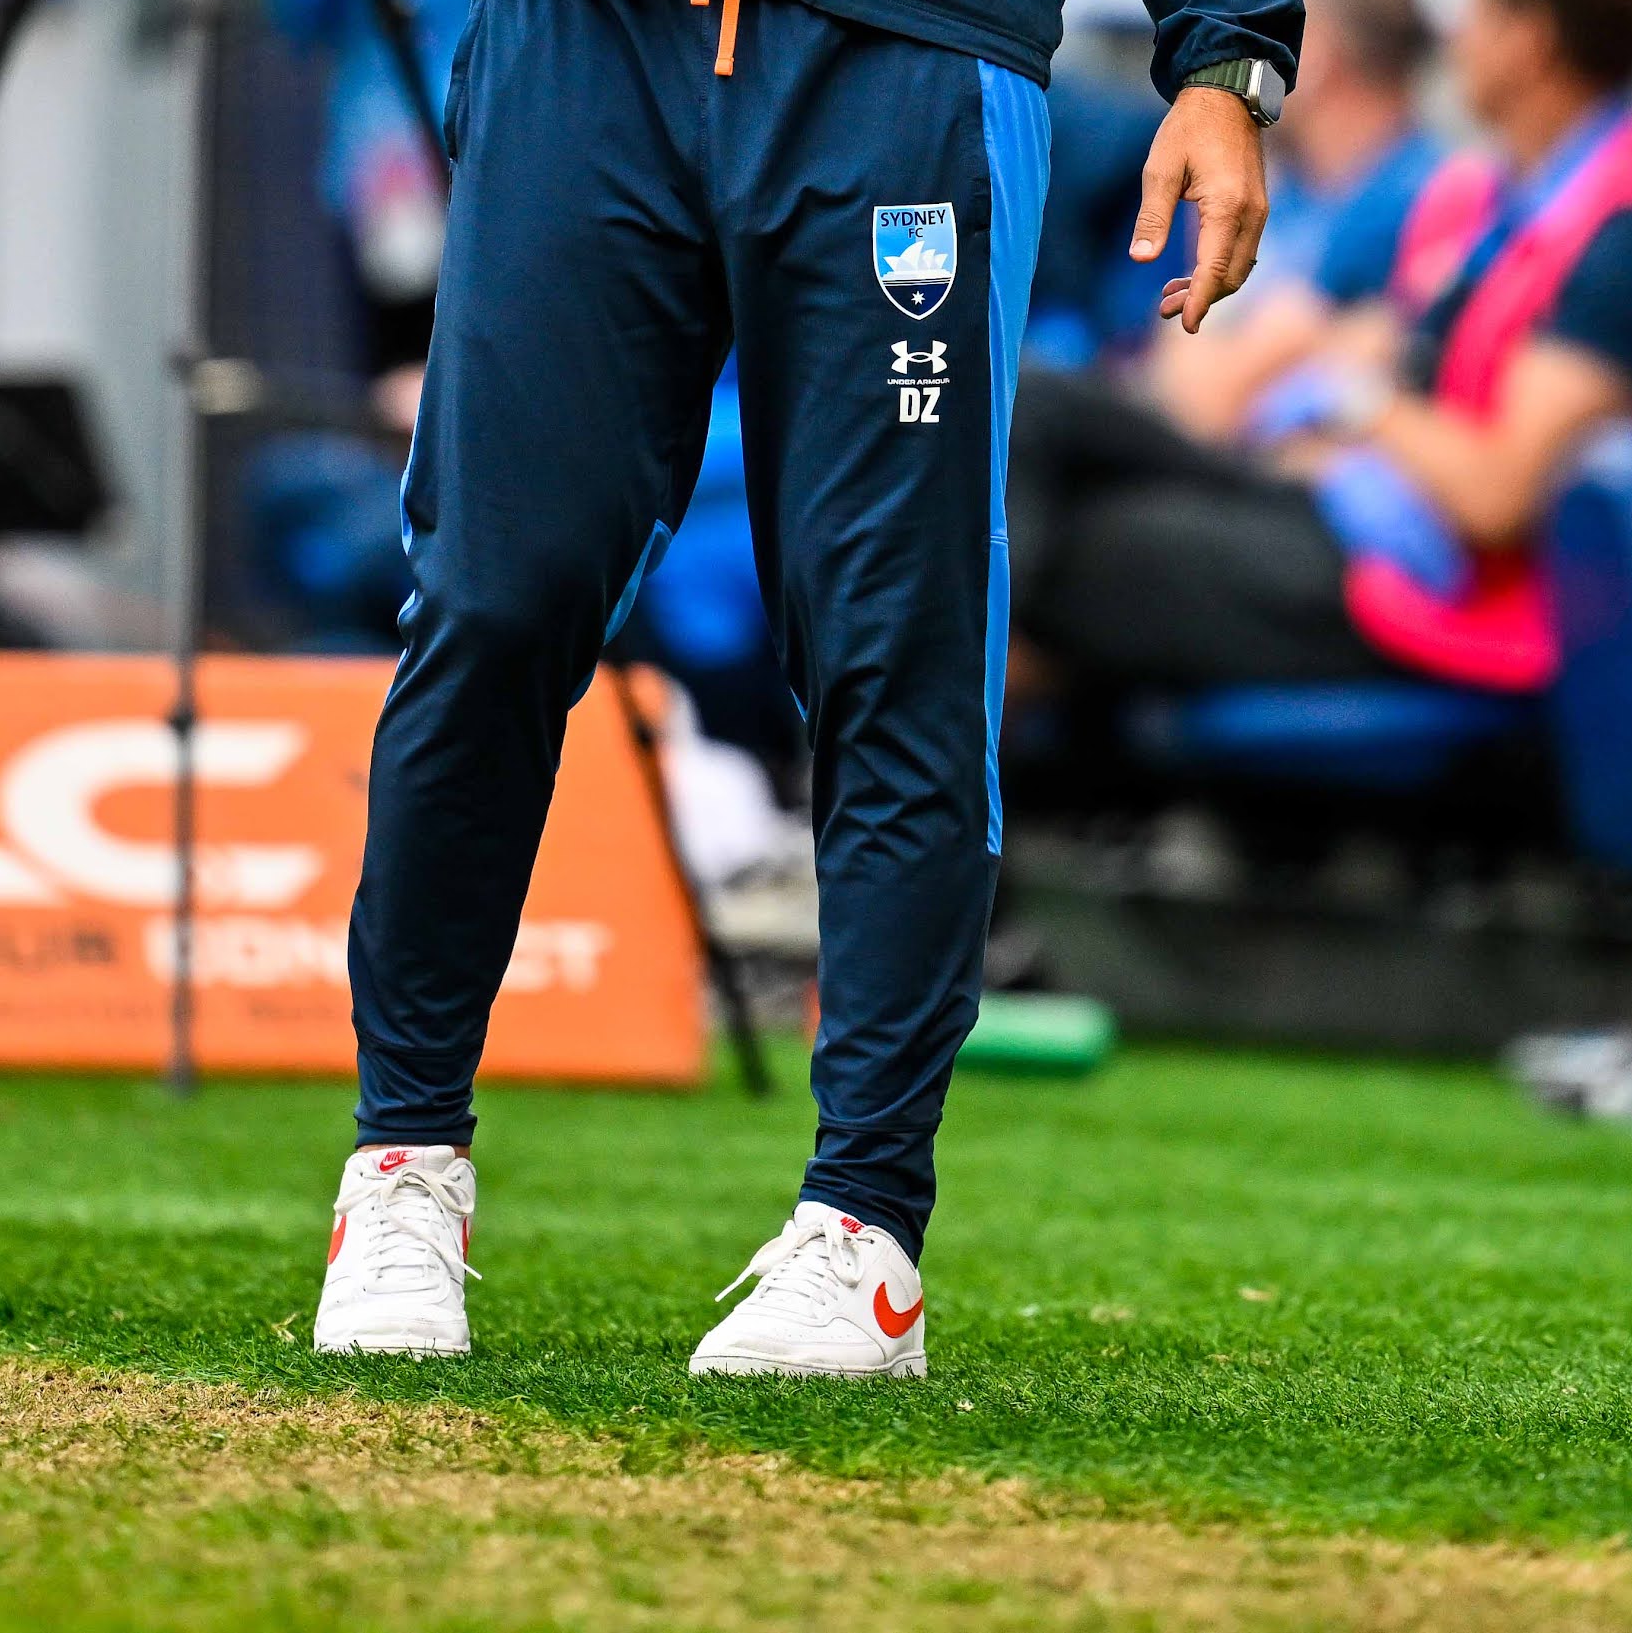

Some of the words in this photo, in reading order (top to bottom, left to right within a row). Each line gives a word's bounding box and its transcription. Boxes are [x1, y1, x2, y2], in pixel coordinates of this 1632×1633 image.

[880, 209, 946, 227] SYDNEY
[908, 227, 924, 238] FC
[886, 378, 916, 386] UNDER
[916, 377, 951, 386] ARMOUR
[899, 386, 941, 423] DZ
